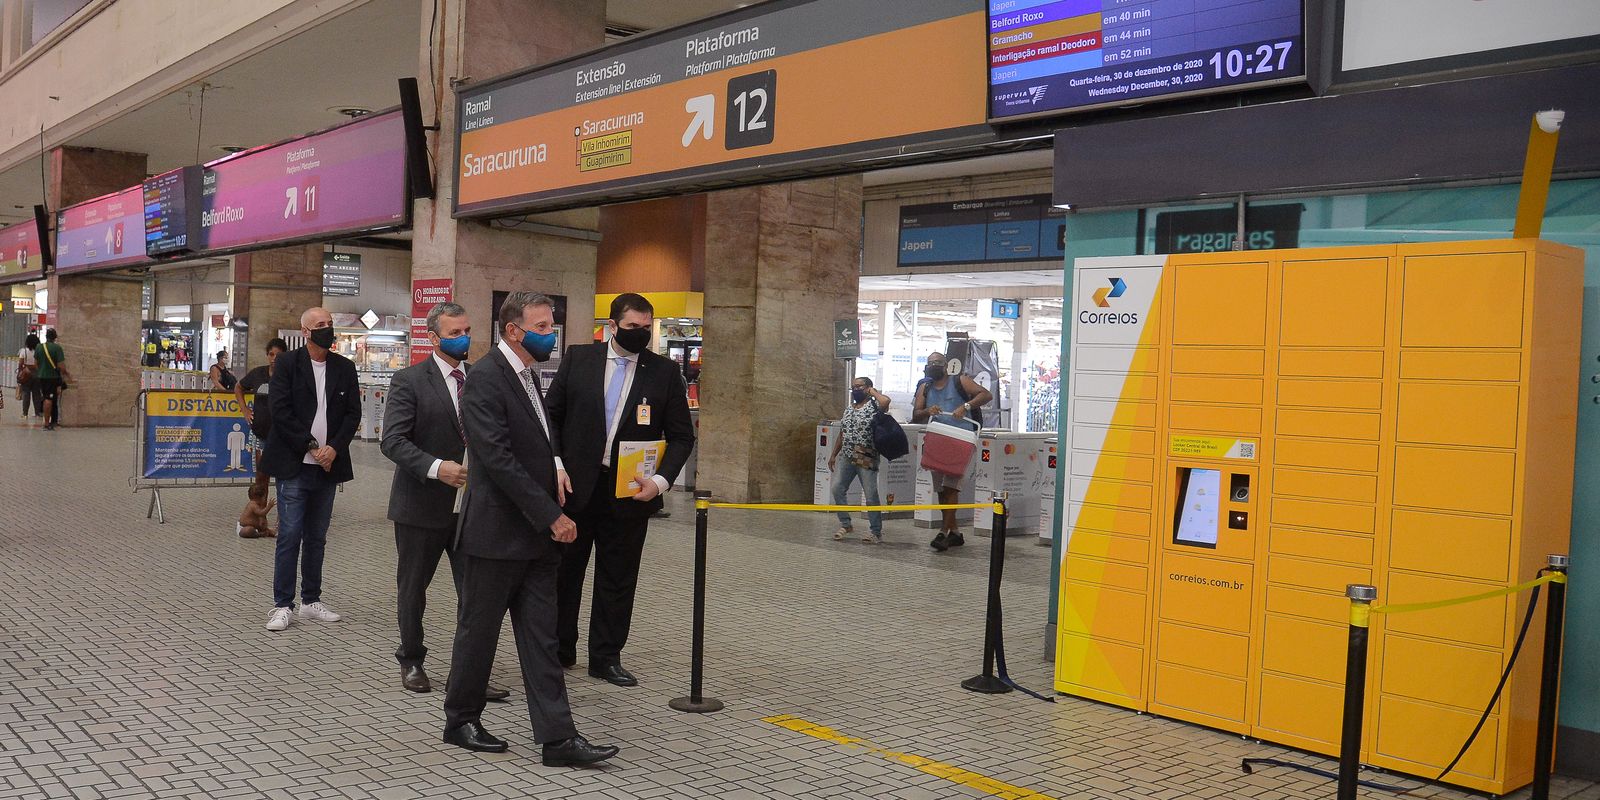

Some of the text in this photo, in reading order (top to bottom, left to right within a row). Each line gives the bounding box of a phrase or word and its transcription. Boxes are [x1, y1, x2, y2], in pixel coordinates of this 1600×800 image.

[992, 12, 1044, 28] Belford Roxo
[1104, 8, 1150, 24] em 40 min
[686, 26, 759, 58] Plataforma
[993, 32, 1033, 45] Gramacho
[1104, 27, 1150, 43] em 44 min
[993, 38, 1096, 63] Interligação ramal Deodoro
[1104, 47, 1151, 62] em 52 min
[1209, 41, 1292, 79] 10:27
[685, 46, 776, 77] Platform Plataforma
[576, 61, 626, 87] Extensão
[993, 69, 1017, 80] Japeri
[1070, 59, 1203, 87] Quarta-feira, 30 de dezembro de 2020
[575, 73, 661, 103] Extension line Extensión
[1088, 73, 1203, 97] Wednesday December, 30, 2020
[465, 95, 491, 116] Ramal
[733, 88, 767, 132] 12
[465, 120, 477, 130] Line
[582, 111, 644, 136] Saracuruna
[582, 134, 630, 152] Vila Inhomirim
[286, 147, 315, 163] Plataforma
[463, 143, 547, 177] Saracuruna
[586, 152, 624, 167] Guapimirim
[204, 173, 216, 185] Ramal
[305, 186, 316, 212] 11
[953, 202, 983, 210] Embarque
[202, 205, 244, 227] Belford Roxo
[116, 229, 122, 248] 8
[902, 239, 933, 251] Japeri
[1177, 230, 1275, 253] aganes
[1079, 310, 1138, 325] Correios
[837, 338, 857, 346] Saída
[167, 395, 254, 412] DISTÂNCA
[1169, 572, 1244, 591] correios.com.br
